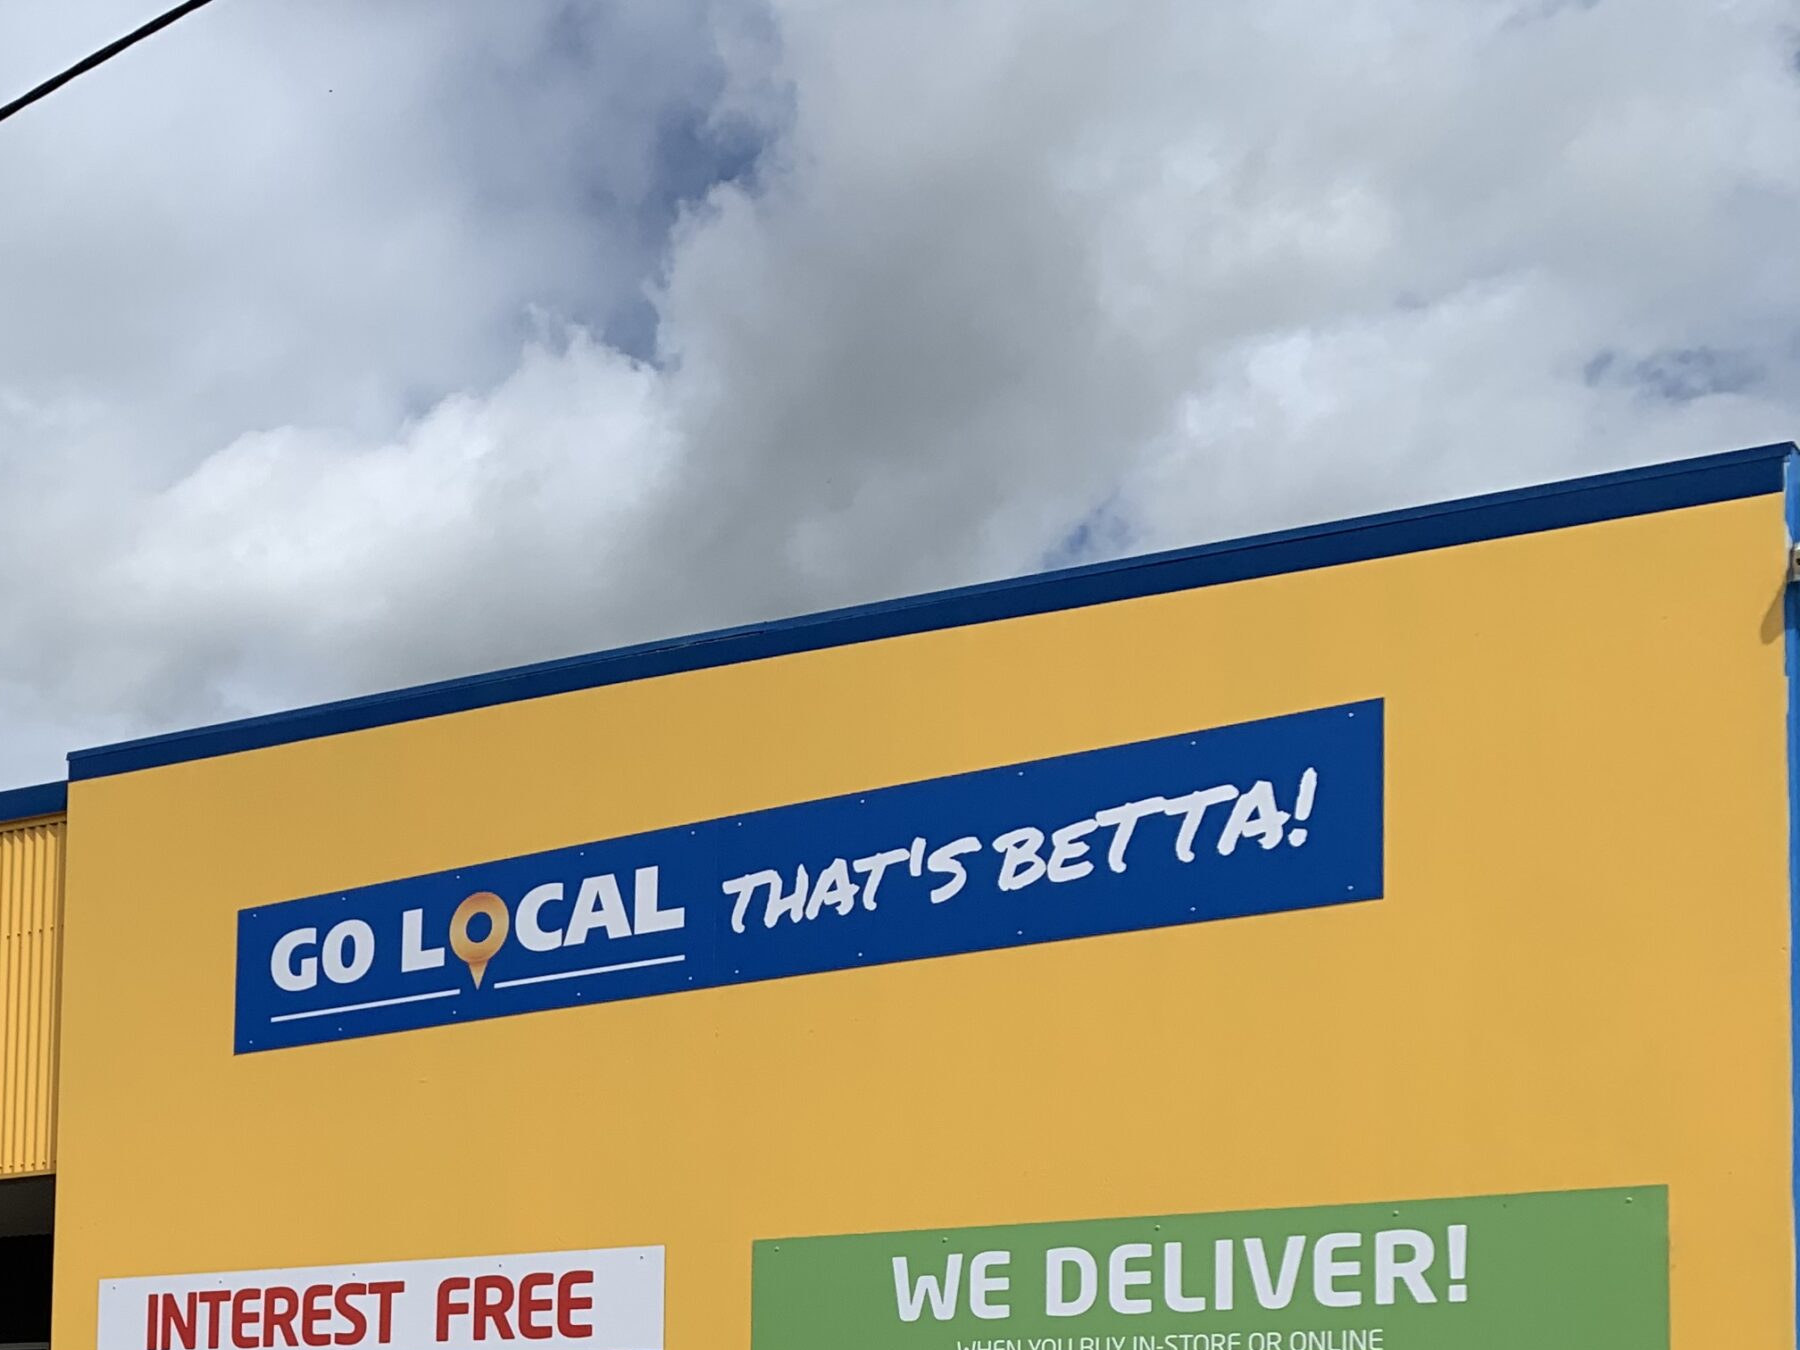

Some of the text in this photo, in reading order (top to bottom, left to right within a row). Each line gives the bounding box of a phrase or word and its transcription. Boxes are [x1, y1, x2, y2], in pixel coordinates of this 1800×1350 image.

[721, 766, 1319, 935] THAT'S BETTA!
[271, 865, 686, 992] GO LOCAL
[146, 1270, 594, 1350] INTEREST FREE
[892, 1223, 1469, 1323] WE DELIVER!
